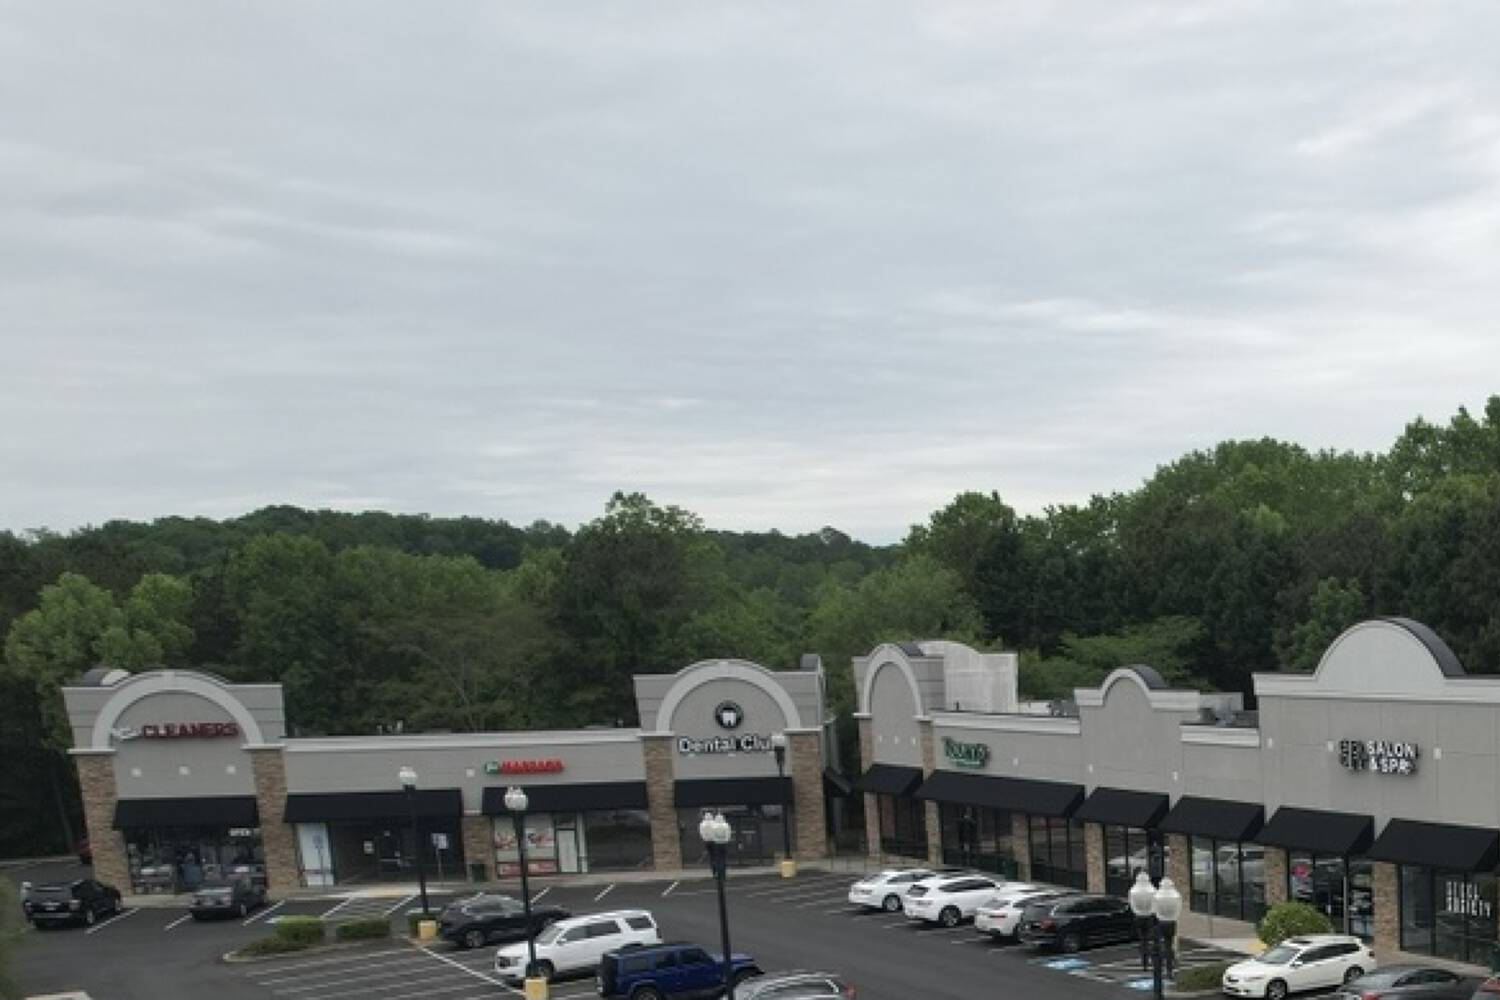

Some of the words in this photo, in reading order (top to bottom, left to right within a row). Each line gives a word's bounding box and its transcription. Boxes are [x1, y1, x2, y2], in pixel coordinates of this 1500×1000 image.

[679, 736, 737, 753] Dental
[741, 734, 775, 753] Clu
[1366, 740, 1417, 759] SALON
